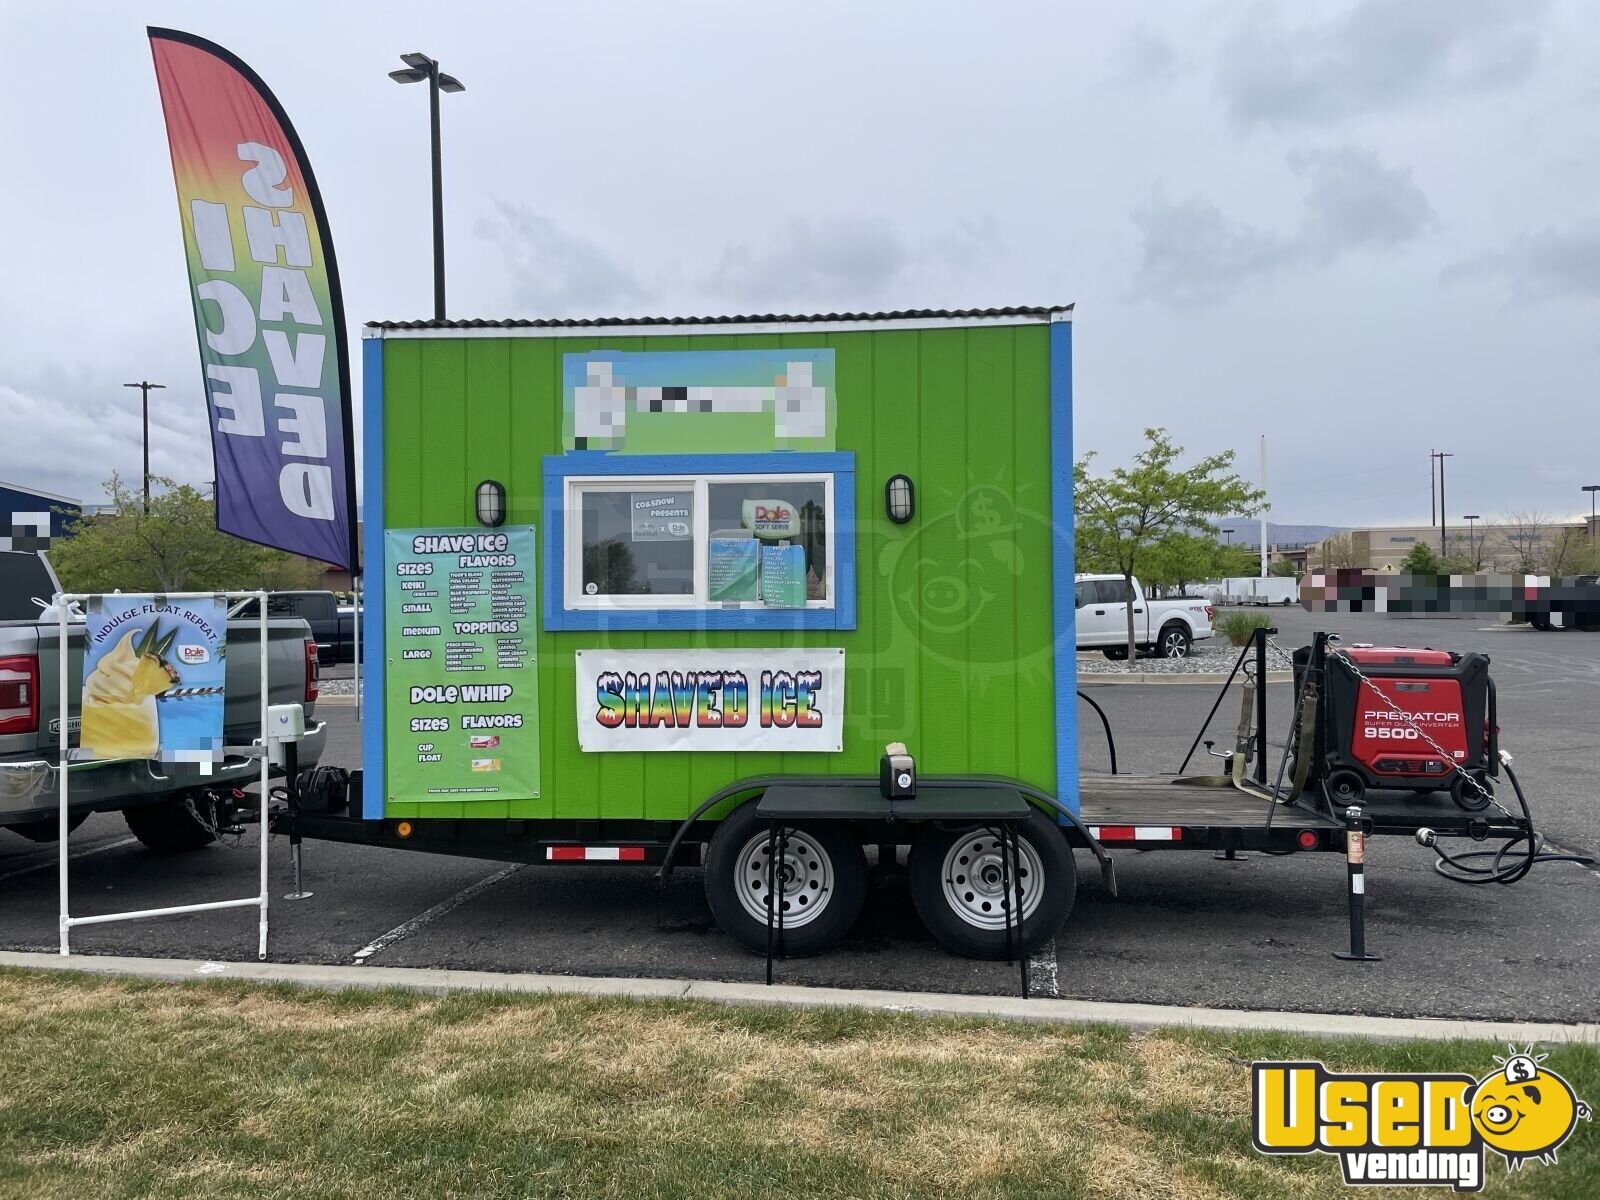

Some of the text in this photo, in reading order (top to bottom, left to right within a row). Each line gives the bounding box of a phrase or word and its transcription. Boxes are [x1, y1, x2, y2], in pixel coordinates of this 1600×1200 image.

[756, 506, 790, 520] Dole
[459, 554, 516, 568] FLAVORS
[94, 608, 141, 643] INDULGE.
[183, 611, 218, 644] REPEAT.
[185, 648, 204, 656] Dole
[460, 684, 513, 703] WHIP
[596, 670, 822, 728] SHAVED ICE
[462, 714, 523, 729] FLAVORS
[1364, 711, 1459, 721] PREDATOR
[1364, 727, 1418, 739] 9500
[418, 744, 434, 752] CUP
[418, 754, 442, 762] FLOAT
